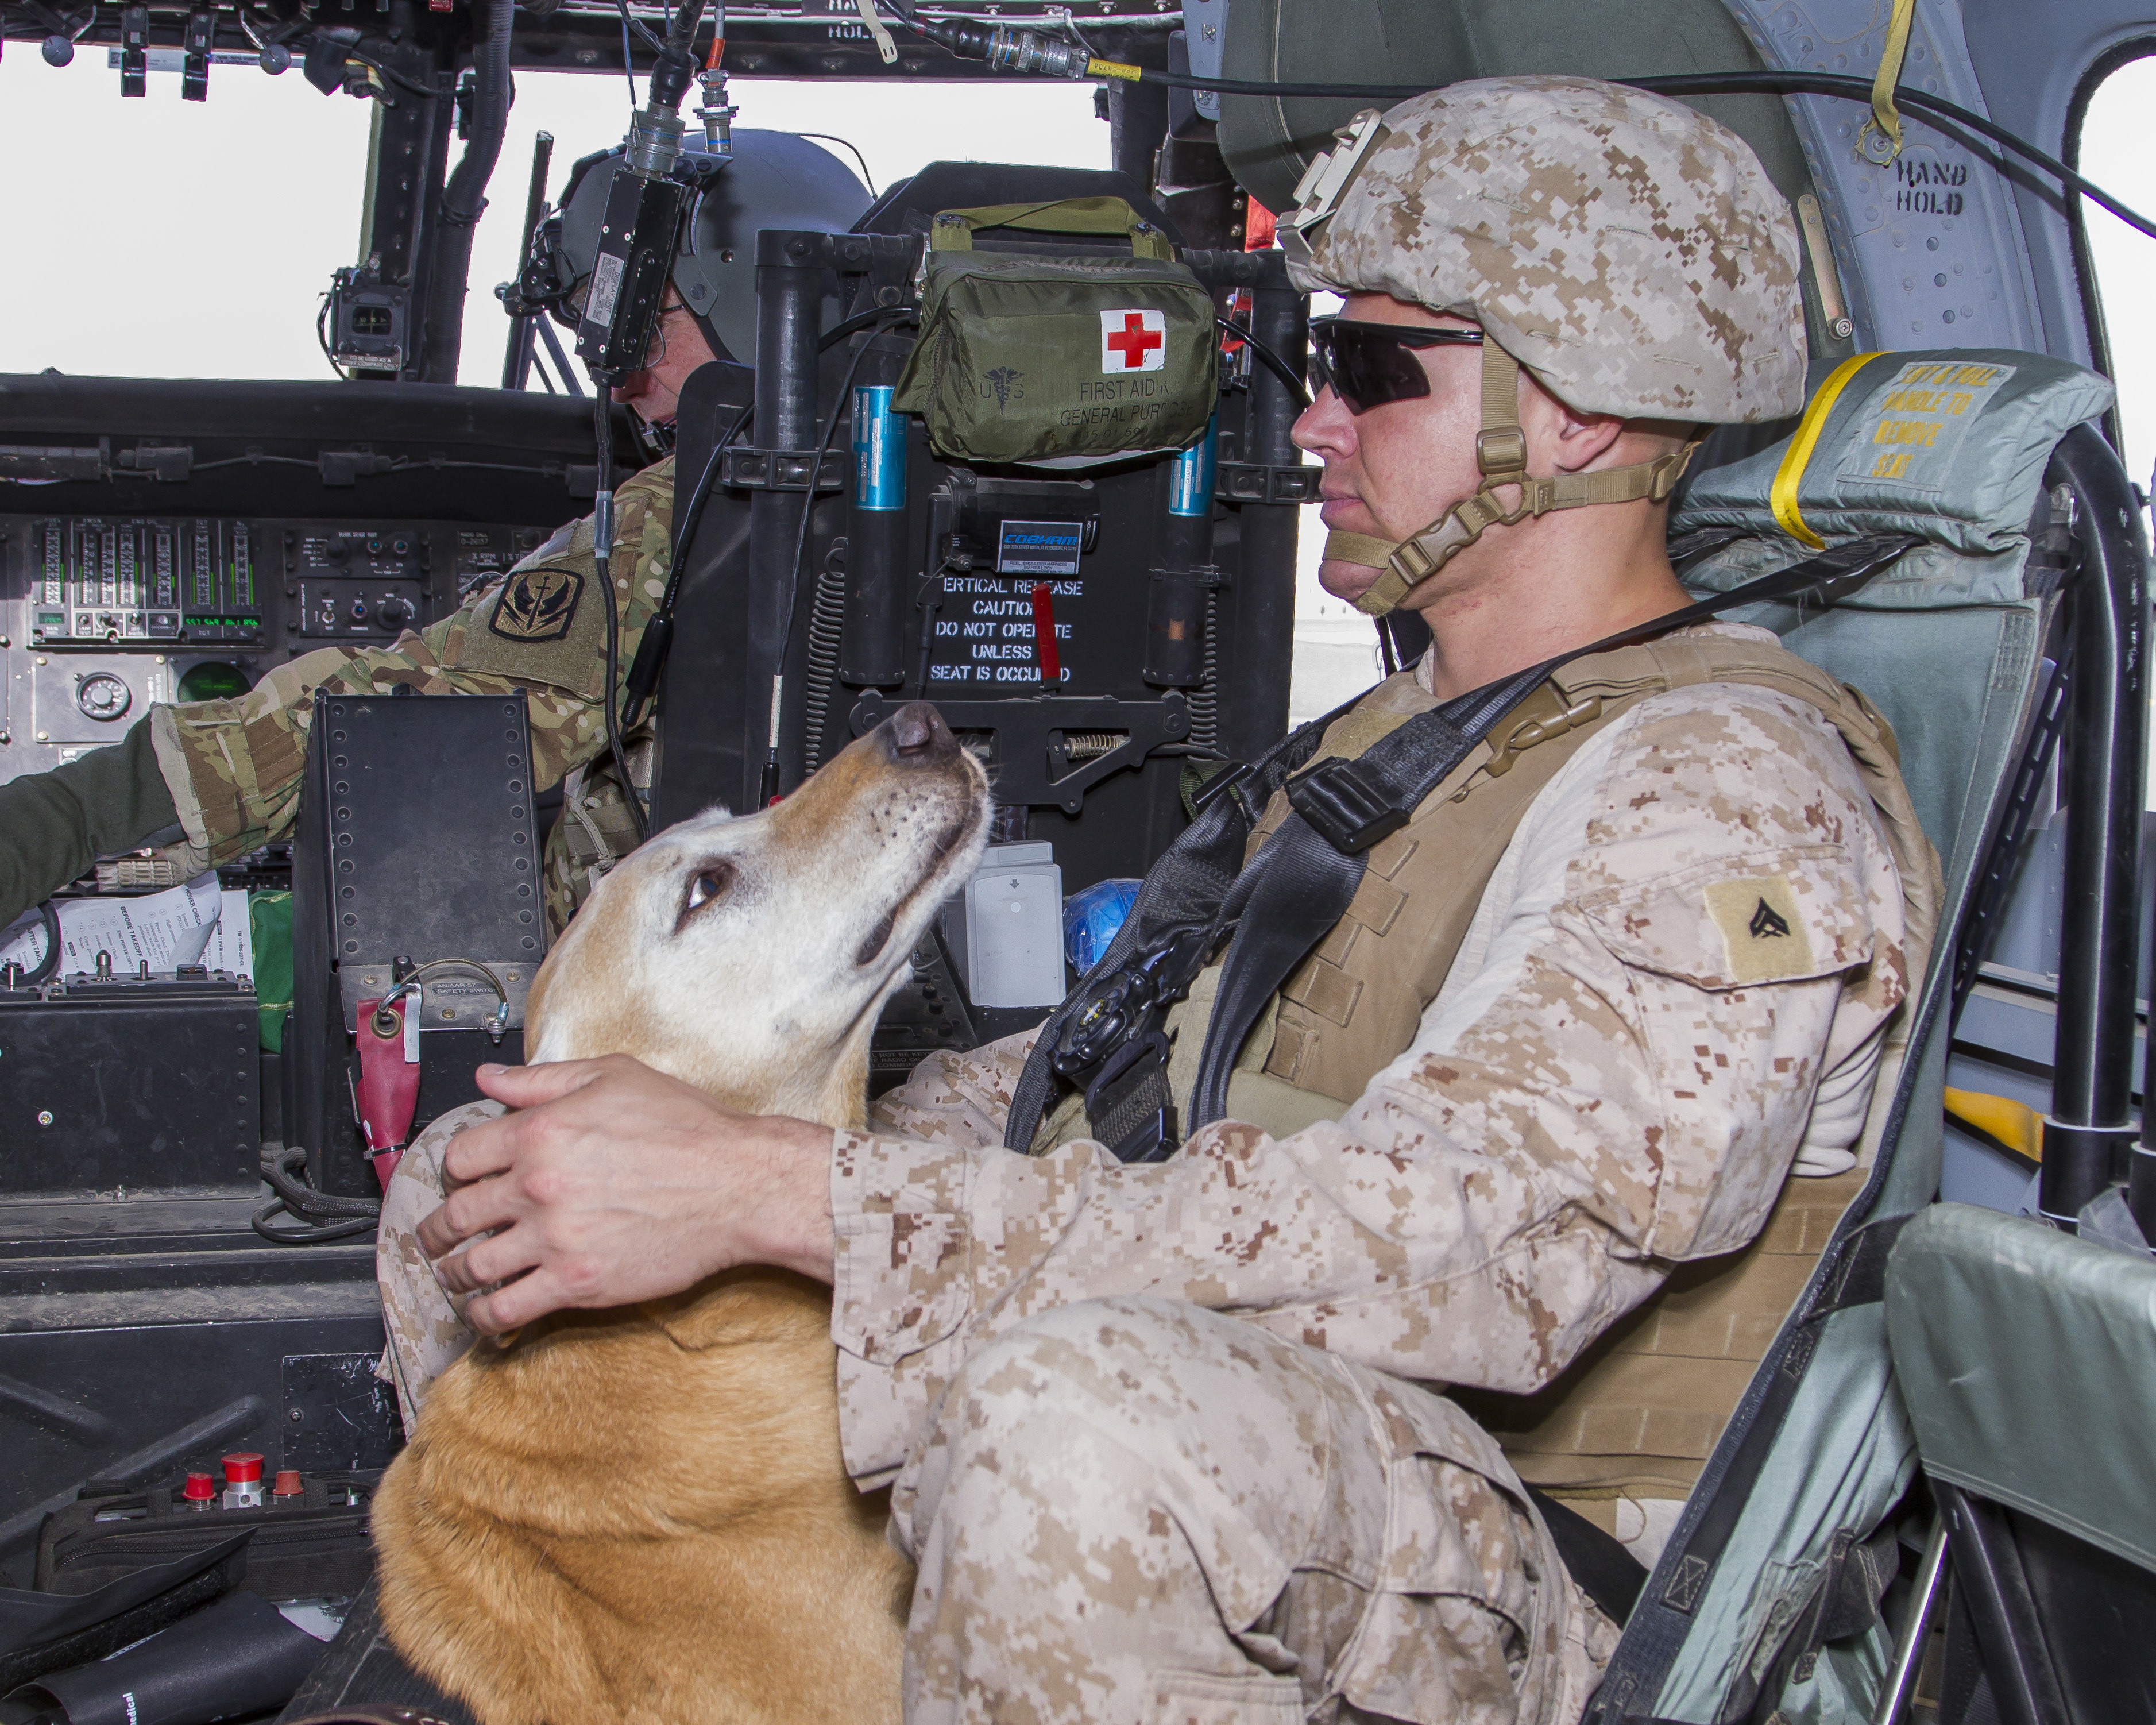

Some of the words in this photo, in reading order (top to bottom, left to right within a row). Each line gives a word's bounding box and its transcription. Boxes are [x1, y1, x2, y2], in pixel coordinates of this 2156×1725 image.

[1896, 160, 1966, 186] HAND
[1897, 190, 1963, 215] HOLD
[606, 300, 614, 314] UNIT
[1948, 366, 1998, 387] PULL
[980, 383, 991, 399] U
[1013, 384, 1024, 399] S
[1080, 380, 1125, 402] FIRST
[1130, 379, 1155, 398] AID
[1881, 390, 1949, 412] HANDLE
[1944, 392, 1972, 416] TO
[1061, 407, 1125, 427] GENERAL
[1873, 420, 1944, 447] REMOVE
[1872, 453, 1914, 478] SEAT
[1004, 534, 1077, 545] COBHAM
[944, 578, 1008, 593] ERTICAL
[973, 600, 1033, 616] CAUTIO
[936, 622, 958, 636] DO
[964, 622, 996, 636] NOT
[1003, 623, 1072, 639] OPETE
[972, 644, 1033, 659] UNLESS
[930, 665, 972, 680] SEAT
[976, 666, 991, 680] IS
[996, 667, 1071, 682] OCCUD
[120, 906, 133, 929] BEFORE
[185, 888, 196, 908] HOVER
[192, 908, 202, 926] CHECK
[25, 927, 39, 947] AFTER
[32, 946, 46, 966] TAKE
